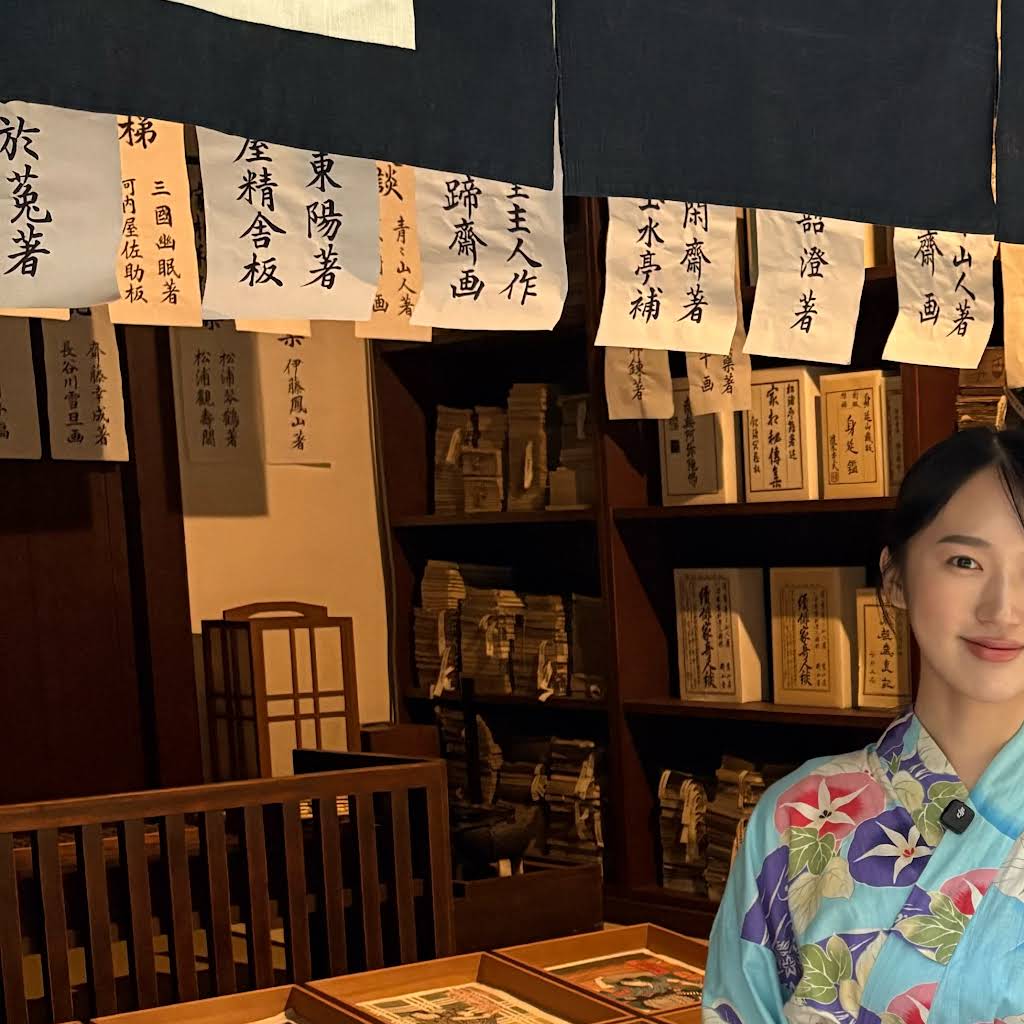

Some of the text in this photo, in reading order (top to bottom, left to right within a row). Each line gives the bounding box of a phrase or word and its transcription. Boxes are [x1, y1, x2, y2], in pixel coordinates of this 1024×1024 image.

[300, 153, 343, 289] 東陽著
[376, 160, 404, 201] 談
[945, 232, 977, 338] 山人著
